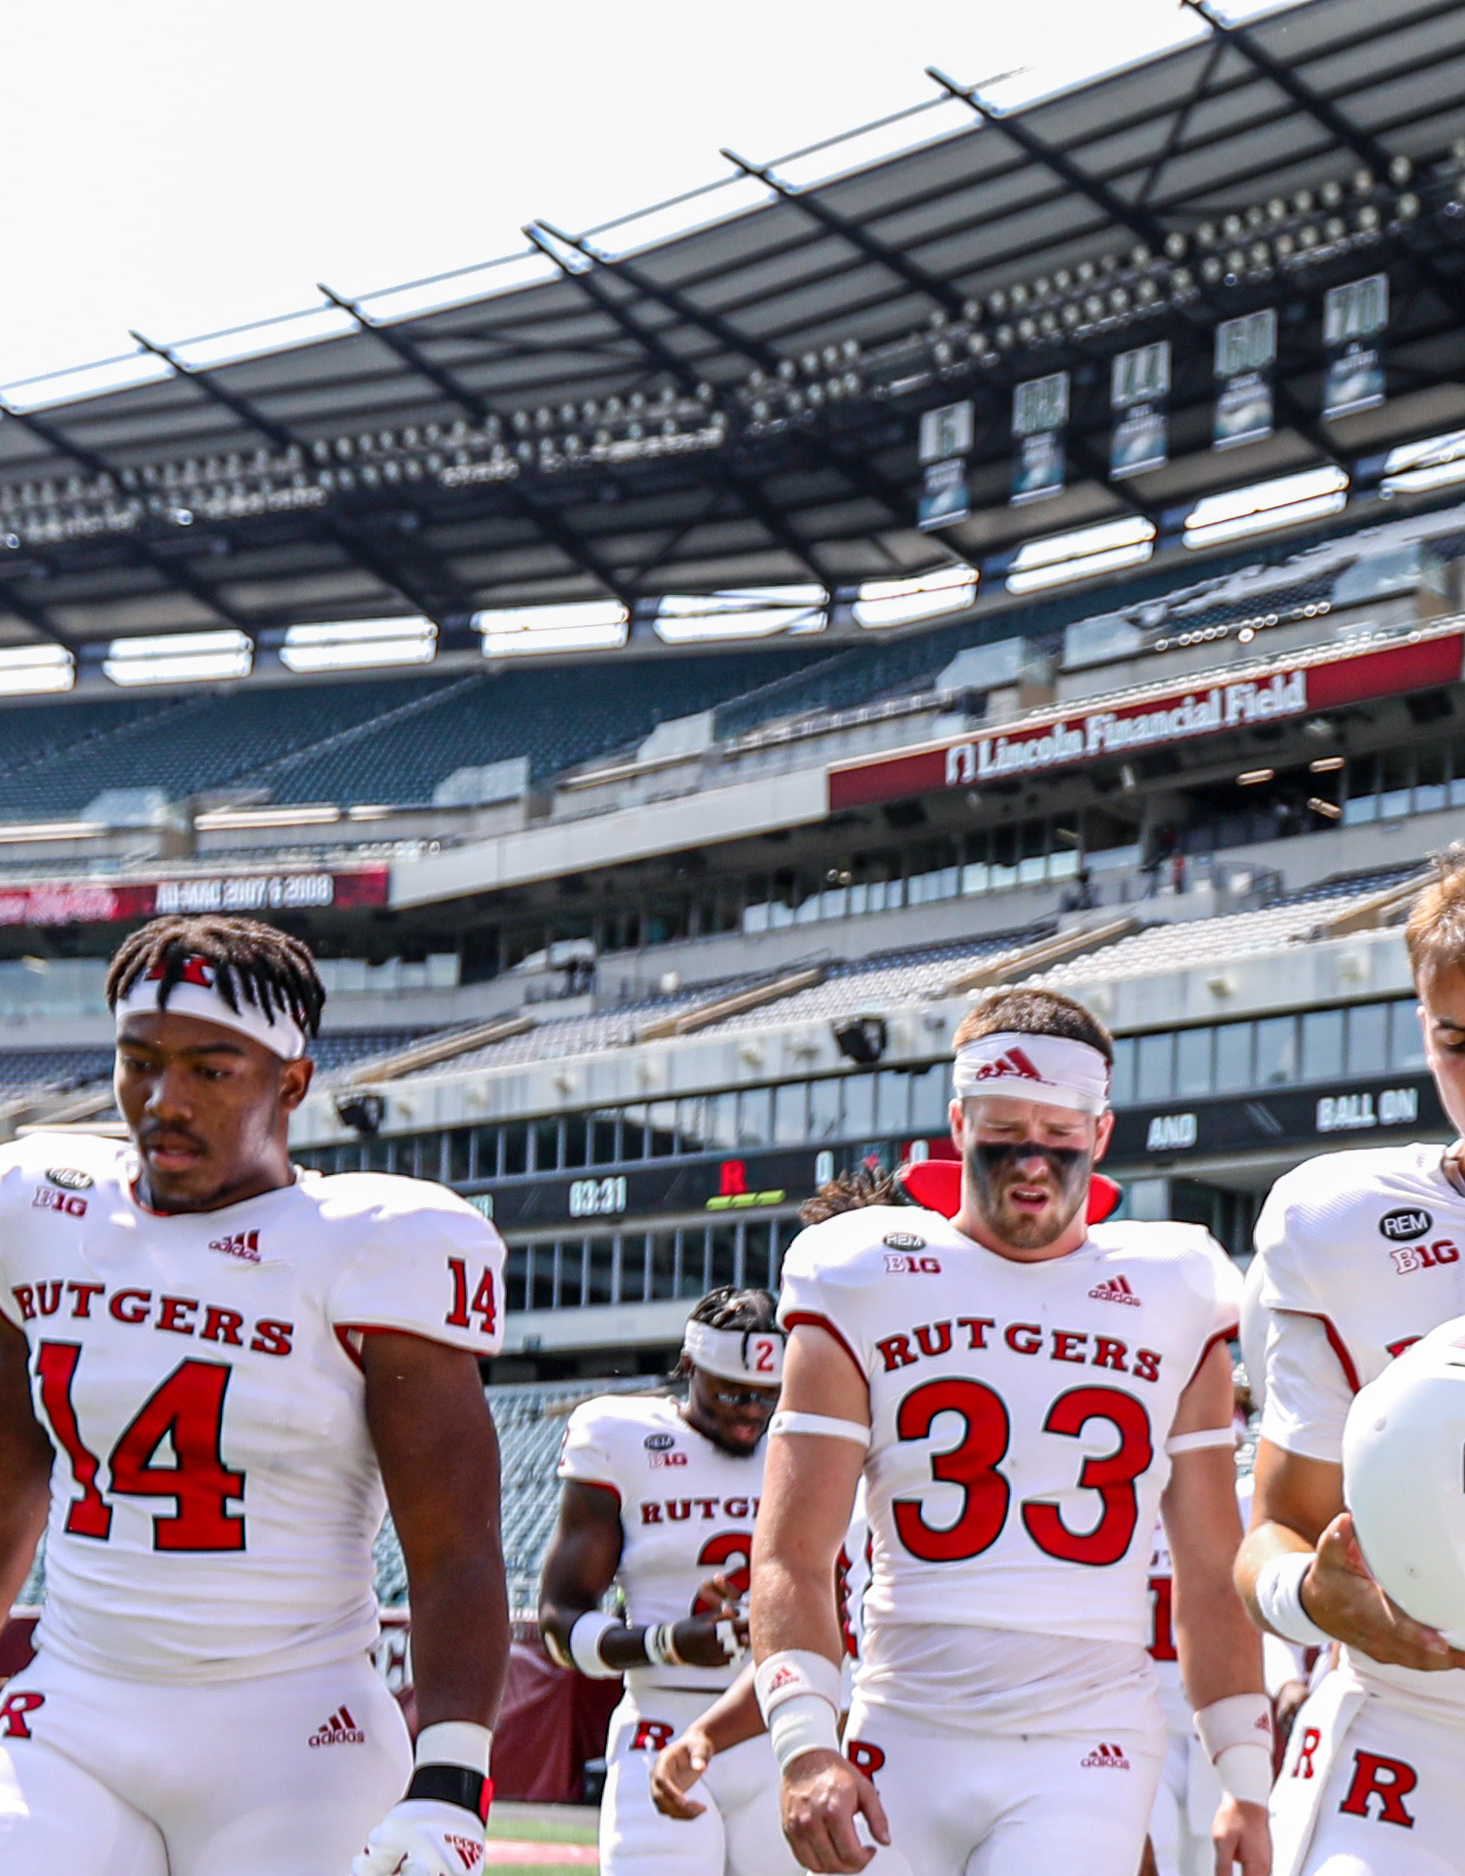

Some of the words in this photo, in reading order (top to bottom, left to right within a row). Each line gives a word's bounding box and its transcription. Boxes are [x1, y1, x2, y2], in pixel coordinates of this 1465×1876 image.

[976, 719, 1084, 780] Lincoln
[1086, 687, 1223, 755] Financial
[1224, 669, 1308, 725] Field
[1316, 1093, 1377, 1133] BALL
[1377, 1087, 1419, 1126] ON
[1146, 1112, 1197, 1152] AND
[1383, 1211, 1430, 1236] REM
[208, 1239, 261, 1263] adidas
[443, 1256, 499, 1336] 14
[1088, 1287, 1142, 1308] adidas
[11, 1280, 294, 1357] RUTGERS
[755, 1340, 775, 1373] 2
[873, 1315, 1163, 1383] RUTGERS
[36, 1340, 247, 1553] 14
[891, 1374, 1154, 1568] 33
[640, 1498, 759, 1525] RUTG
[308, 1727, 365, 1748] adidas
[629, 1720, 676, 1752] R
[1291, 1726, 1323, 1780] R
[1080, 1756, 1131, 1771] adidas
[1338, 1748, 1419, 1830] R
